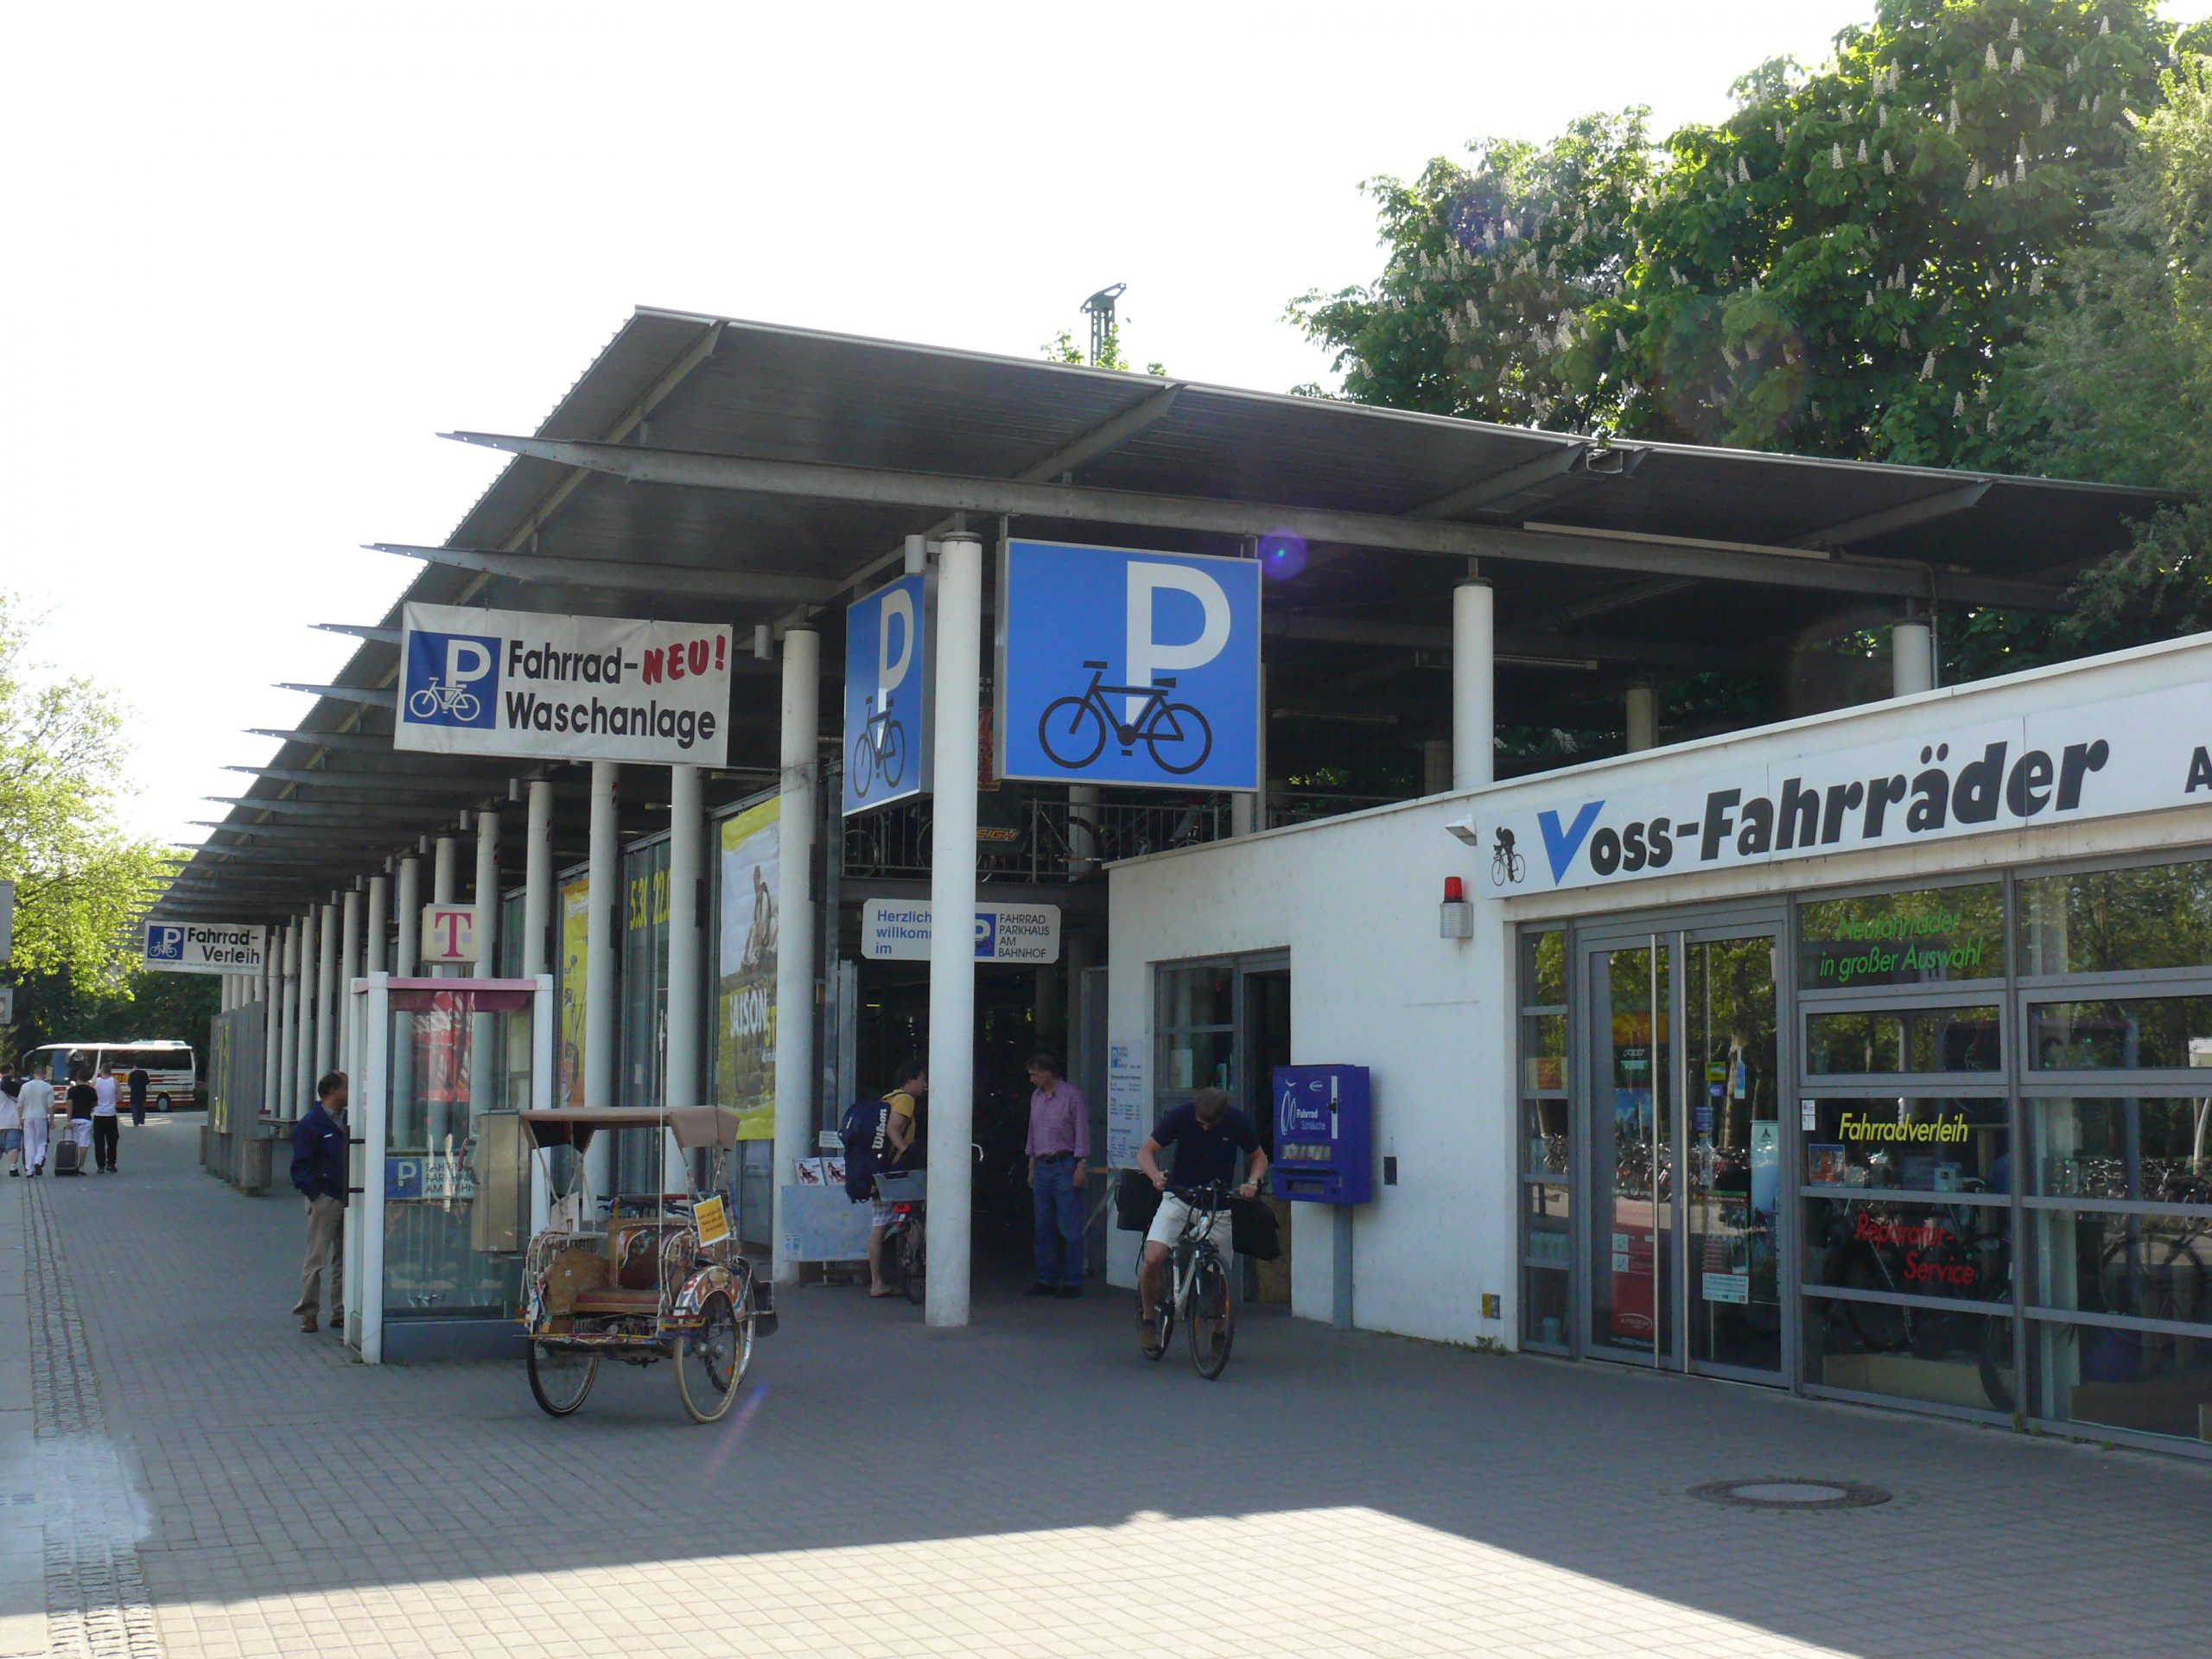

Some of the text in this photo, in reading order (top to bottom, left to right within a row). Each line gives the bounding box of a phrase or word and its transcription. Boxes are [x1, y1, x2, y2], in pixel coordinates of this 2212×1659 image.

[507, 634, 726, 685] Fahrrad- NEU!
[505, 691, 716, 749] Waschanlage
[1536, 739, 2110, 887] Voss-Fahrräder
[877, 910, 931, 924] Herzlich
[1000, 913, 1046, 925] FAHRRAD
[187, 927, 259, 945] Fahrrad-
[435, 912, 472, 957] T
[876, 927, 931, 939] willkom
[999, 925, 1050, 936] PARKHAUS
[875, 942, 893, 954] im
[999, 936, 1016, 946] AM
[201, 945, 260, 964] Verleih
[998, 948, 1046, 958] BAHNHOF
[1820, 936, 1984, 983] in großer Auswahl
[1296, 1109, 1319, 1119] Fahrrad
[871, 1108, 888, 1150] Wilson
[1838, 1112, 1969, 1143] Fahrradverleih
[425, 1185, 443, 1193] AM
[1854, 1213, 1955, 1252] Reparatur-
[1904, 1249, 1976, 1285] Service
